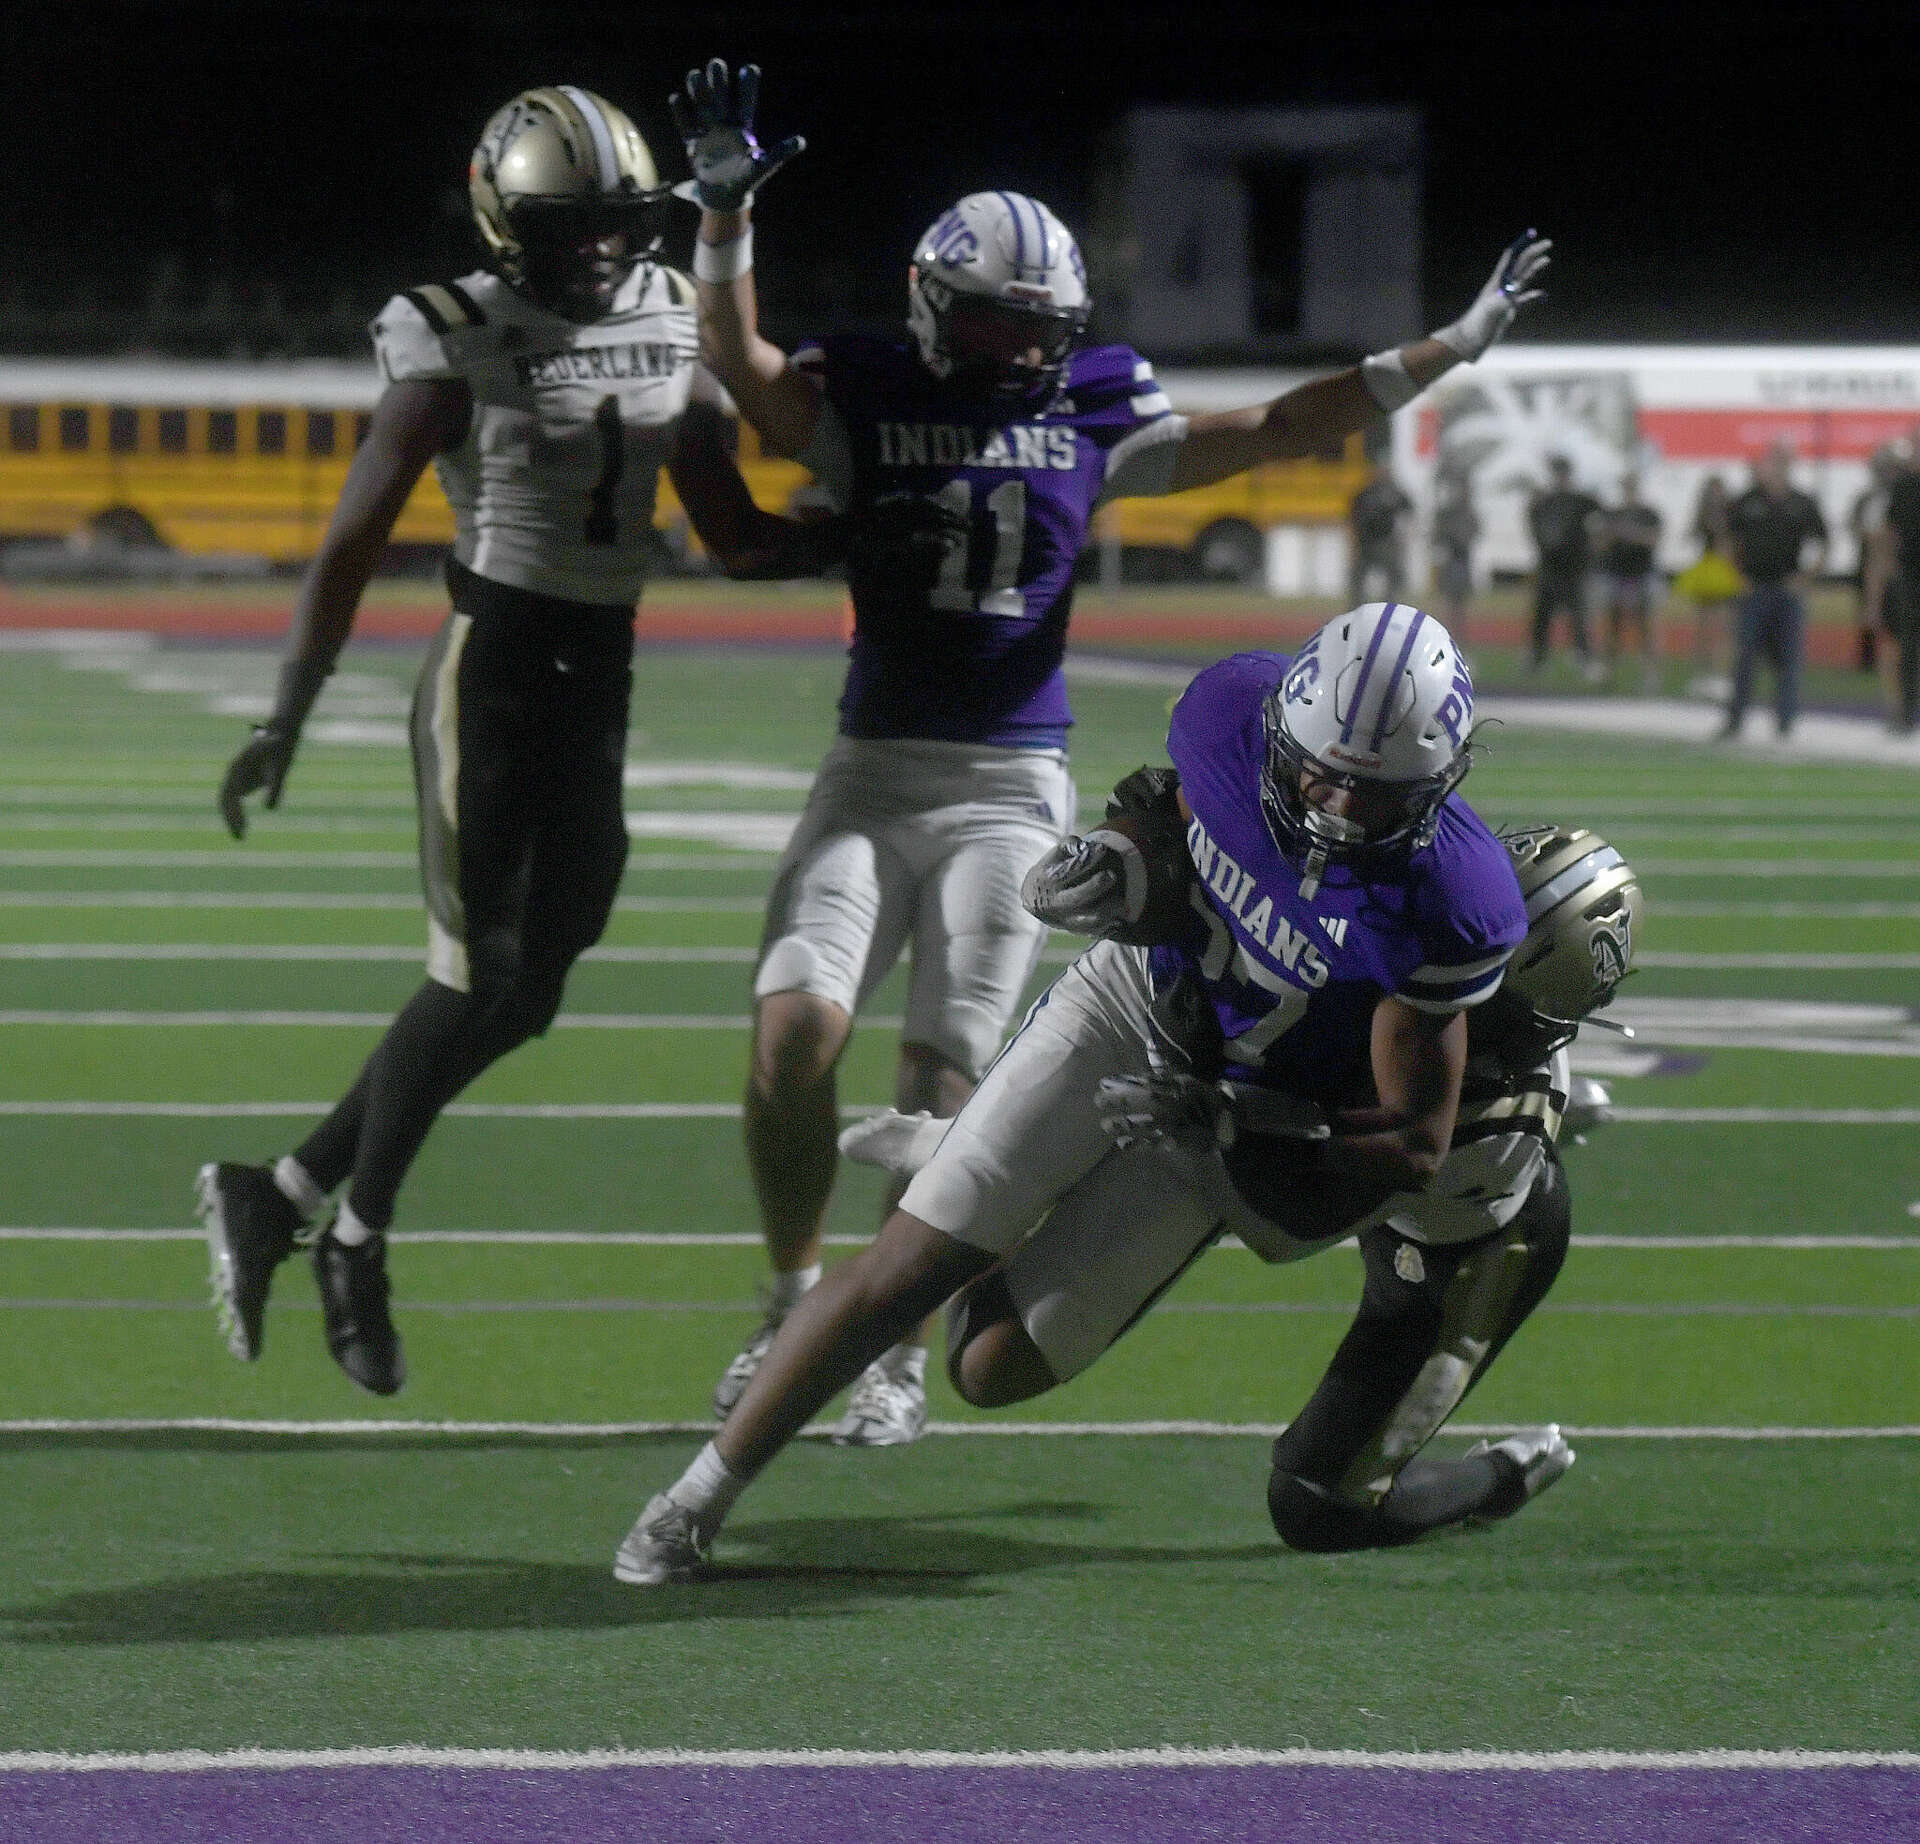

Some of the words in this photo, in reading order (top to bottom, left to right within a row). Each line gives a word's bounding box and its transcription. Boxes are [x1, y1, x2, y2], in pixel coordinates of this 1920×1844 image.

[584, 394, 624, 546] 1
[879, 422, 1077, 470] INDIANS
[928, 478, 1027, 618] 11
